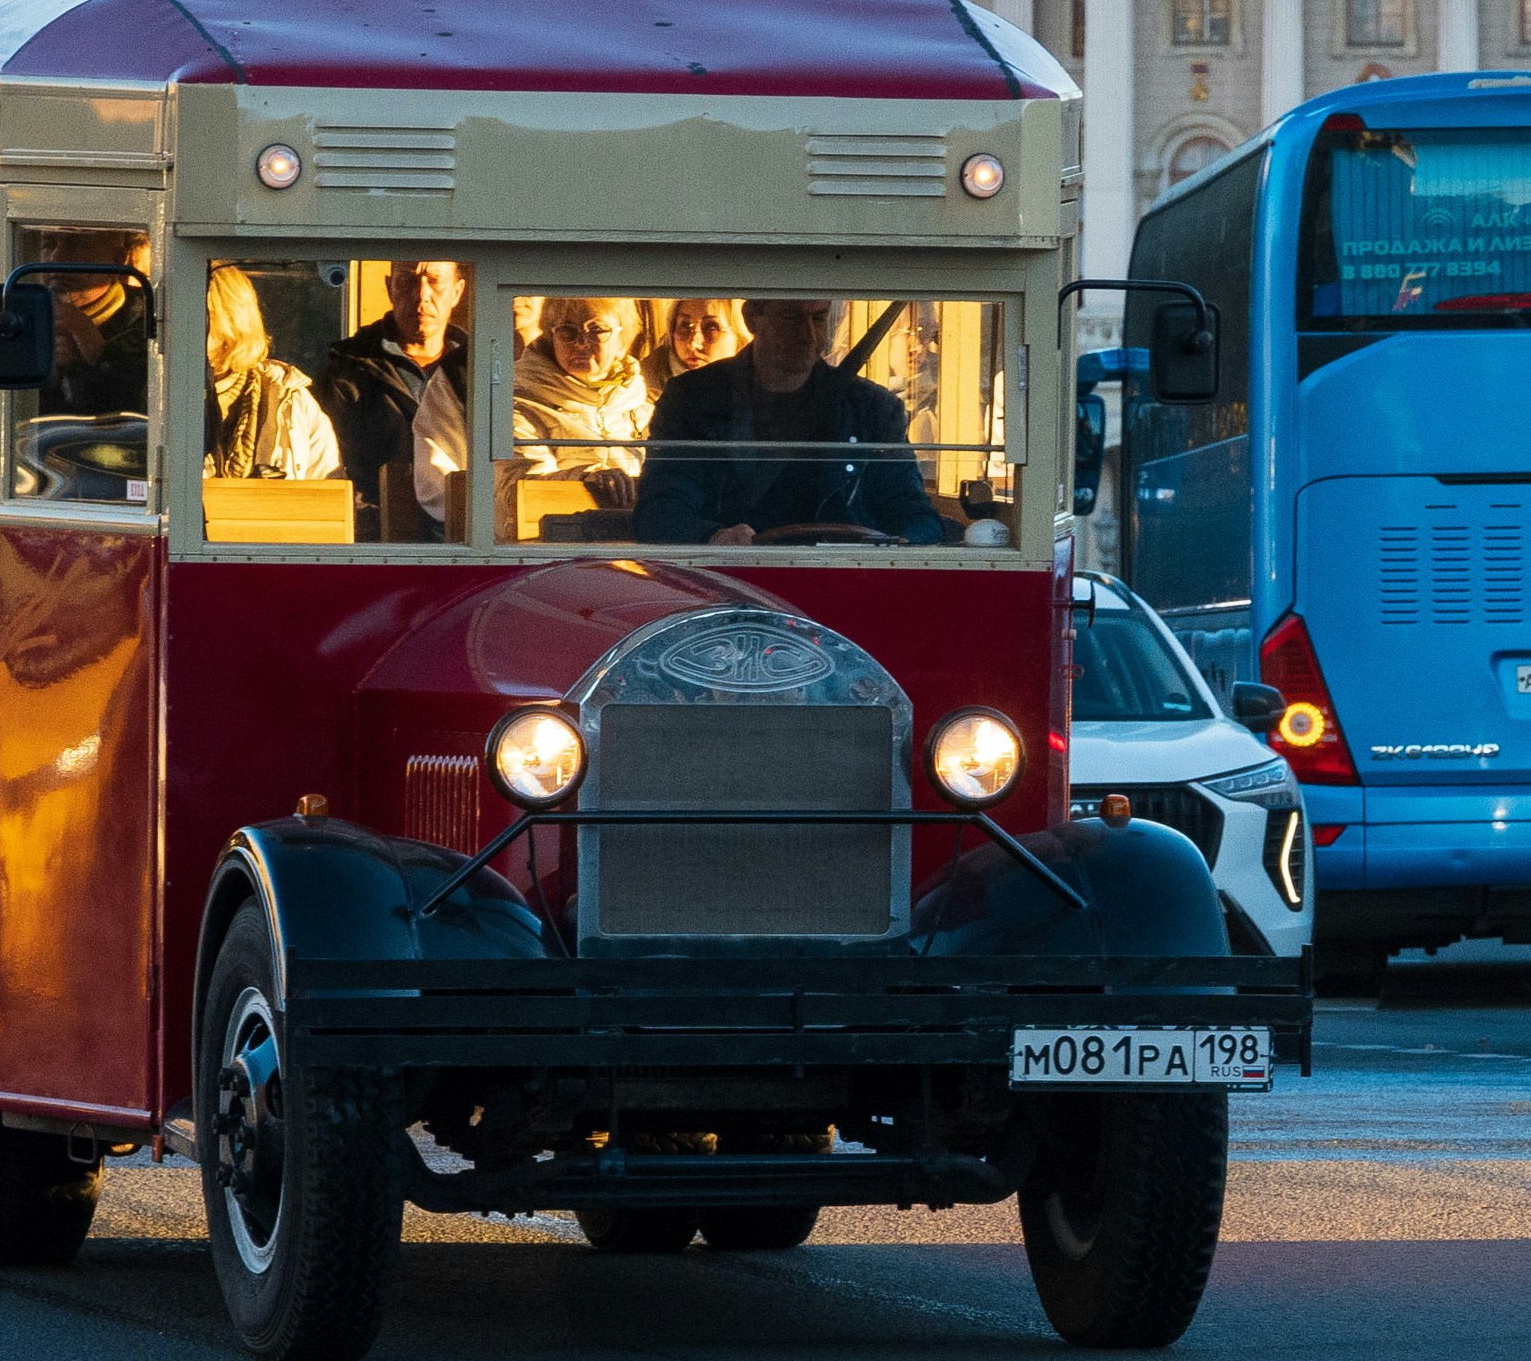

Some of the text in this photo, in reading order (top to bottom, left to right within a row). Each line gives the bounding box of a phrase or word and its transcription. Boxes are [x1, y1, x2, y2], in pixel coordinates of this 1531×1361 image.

[1342, 237, 1463, 256] ПРОДАЖА
[1468, 237, 1486, 253] И
[1342, 264, 1355, 280] 8
[671, 634, 821, 681] ЗИС
[1199, 1034, 1259, 1065] 198
[1210, 1065, 1241, 1077] RUS
